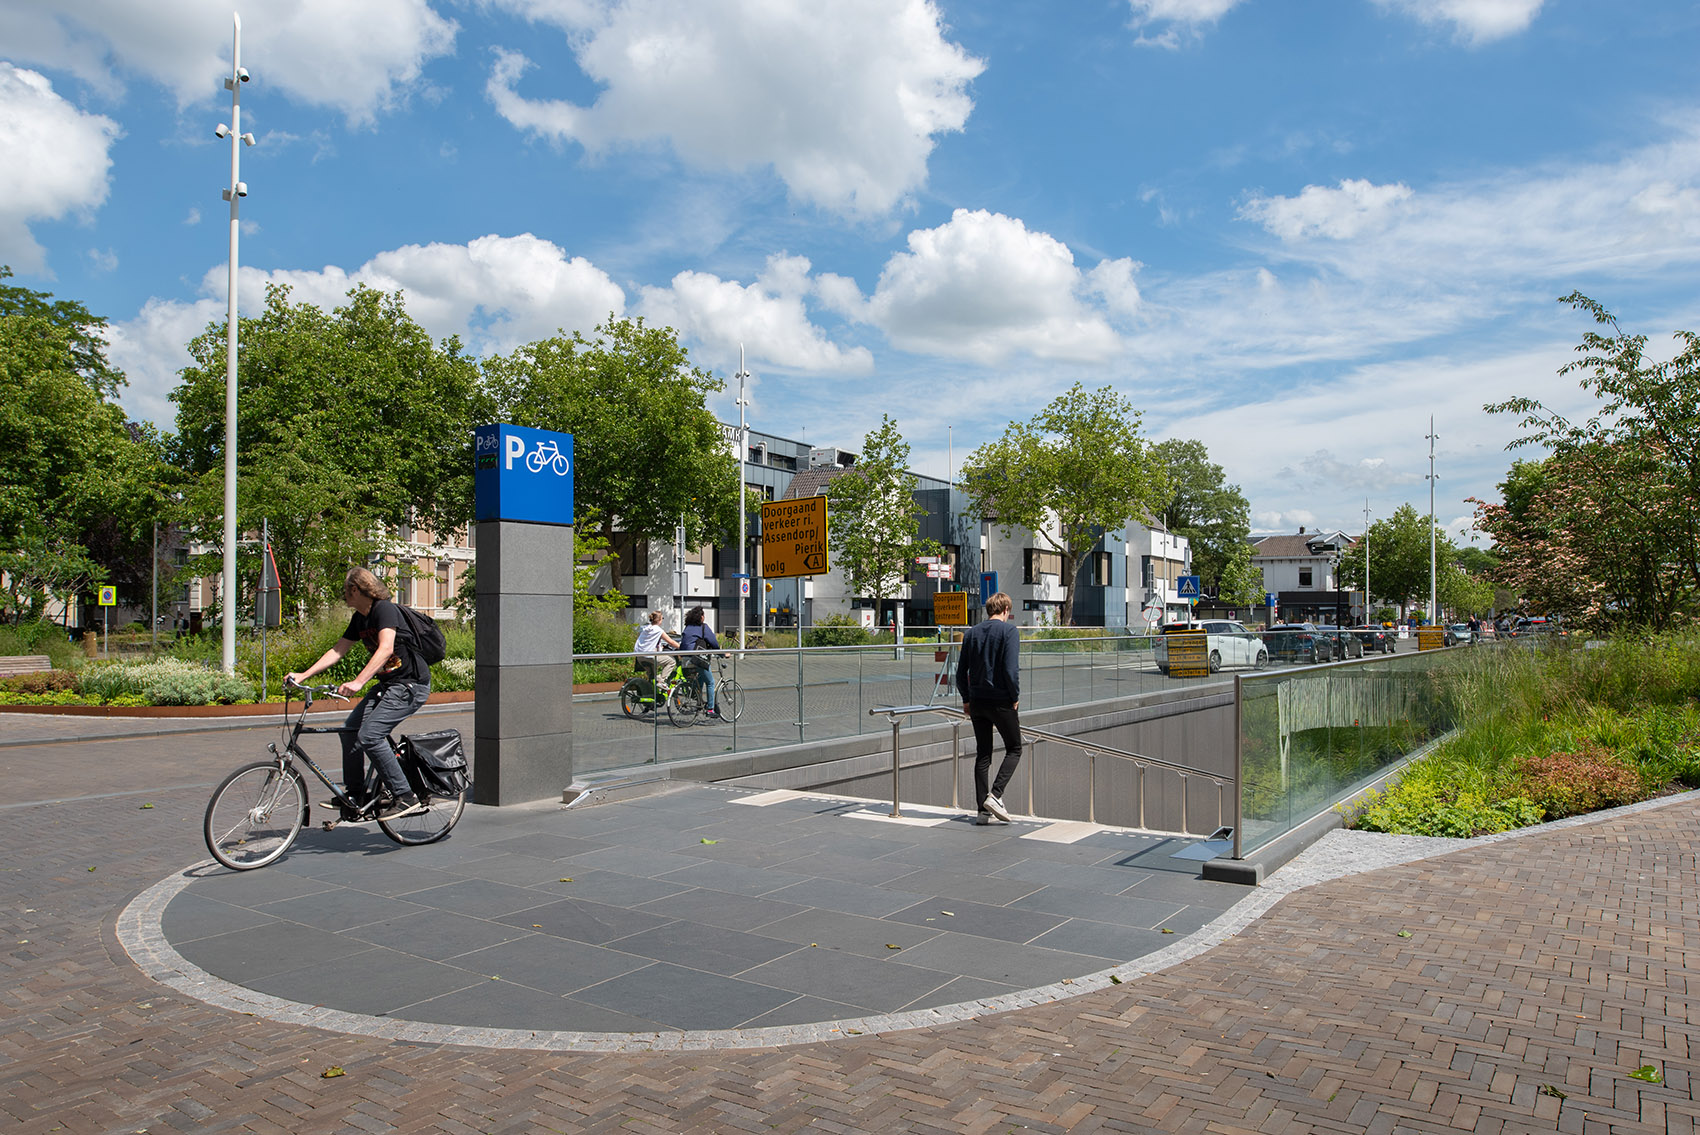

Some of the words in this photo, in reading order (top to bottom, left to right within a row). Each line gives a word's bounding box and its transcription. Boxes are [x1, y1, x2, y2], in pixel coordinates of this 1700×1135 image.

[476, 436, 484, 451] P
[505, 434, 525, 470] P
[764, 500, 816, 518] Doorgaand
[764, 517, 800, 531] verkeer
[803, 514, 814, 526] ri.
[764, 526, 819, 544] Assendorp/
[795, 541, 824, 555] Pierik
[765, 560, 785, 574] volg
[812, 556, 820, 567] A
[934, 594, 963, 603] Doorgaand
